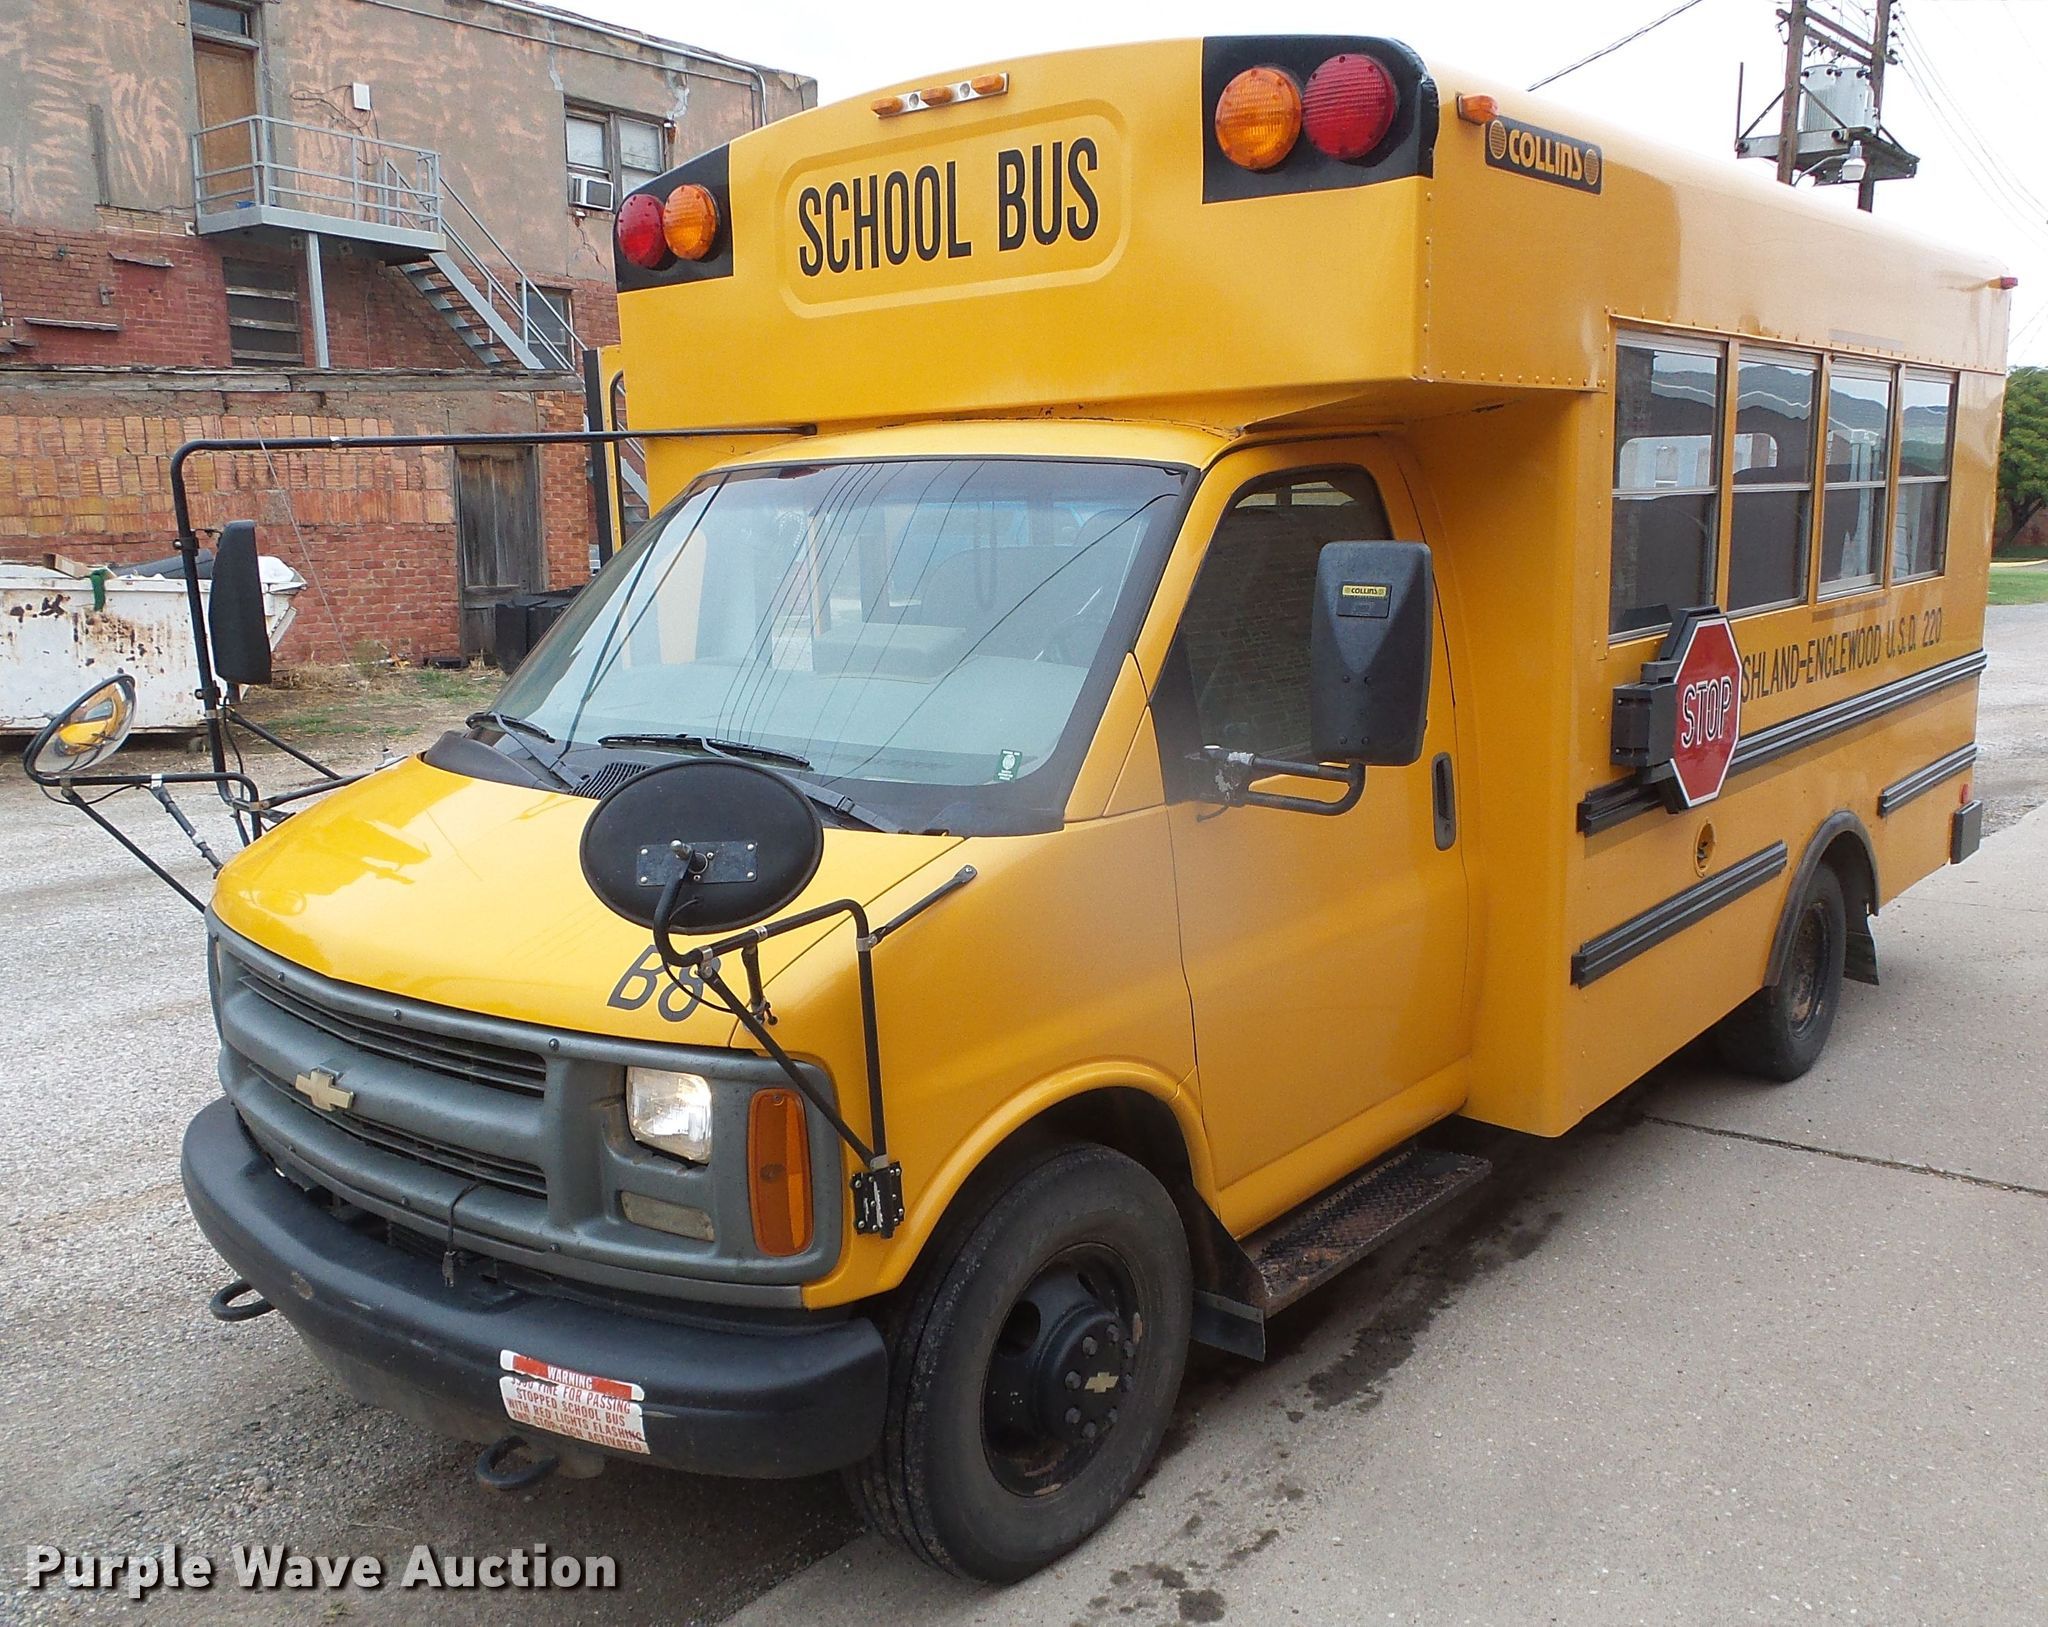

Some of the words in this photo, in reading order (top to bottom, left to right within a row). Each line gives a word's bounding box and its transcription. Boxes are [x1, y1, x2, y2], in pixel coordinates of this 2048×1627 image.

[1508, 129, 1582, 181] COLLINS
[799, 161, 972, 277] SCHOOL
[998, 137, 1099, 252] BUS
[1350, 587, 1378, 595] COLLINS
[1740, 625, 1881, 703] SHLAND-ENGLEWOOD
[1922, 607, 1942, 648] 220
[1681, 675, 1732, 748] STOP
[606, 944, 722, 1022] B8
[548, 1365, 593, 1390] WARNING
[506, 1398, 530, 1413] WITH
[533, 1405, 552, 1419] RED
[555, 1411, 589, 1429] LIGHTS
[592, 1422, 643, 1441] FLASHING
[516, 1387, 558, 1408] STOPPED
[561, 1400, 601, 1421] SCHOOL
[605, 1411, 626, 1427] BUS
[563, 1386, 582, 1402] FOR
[586, 1392, 631, 1414] PASSING
[587, 1432, 643, 1451] ACTIVATED
